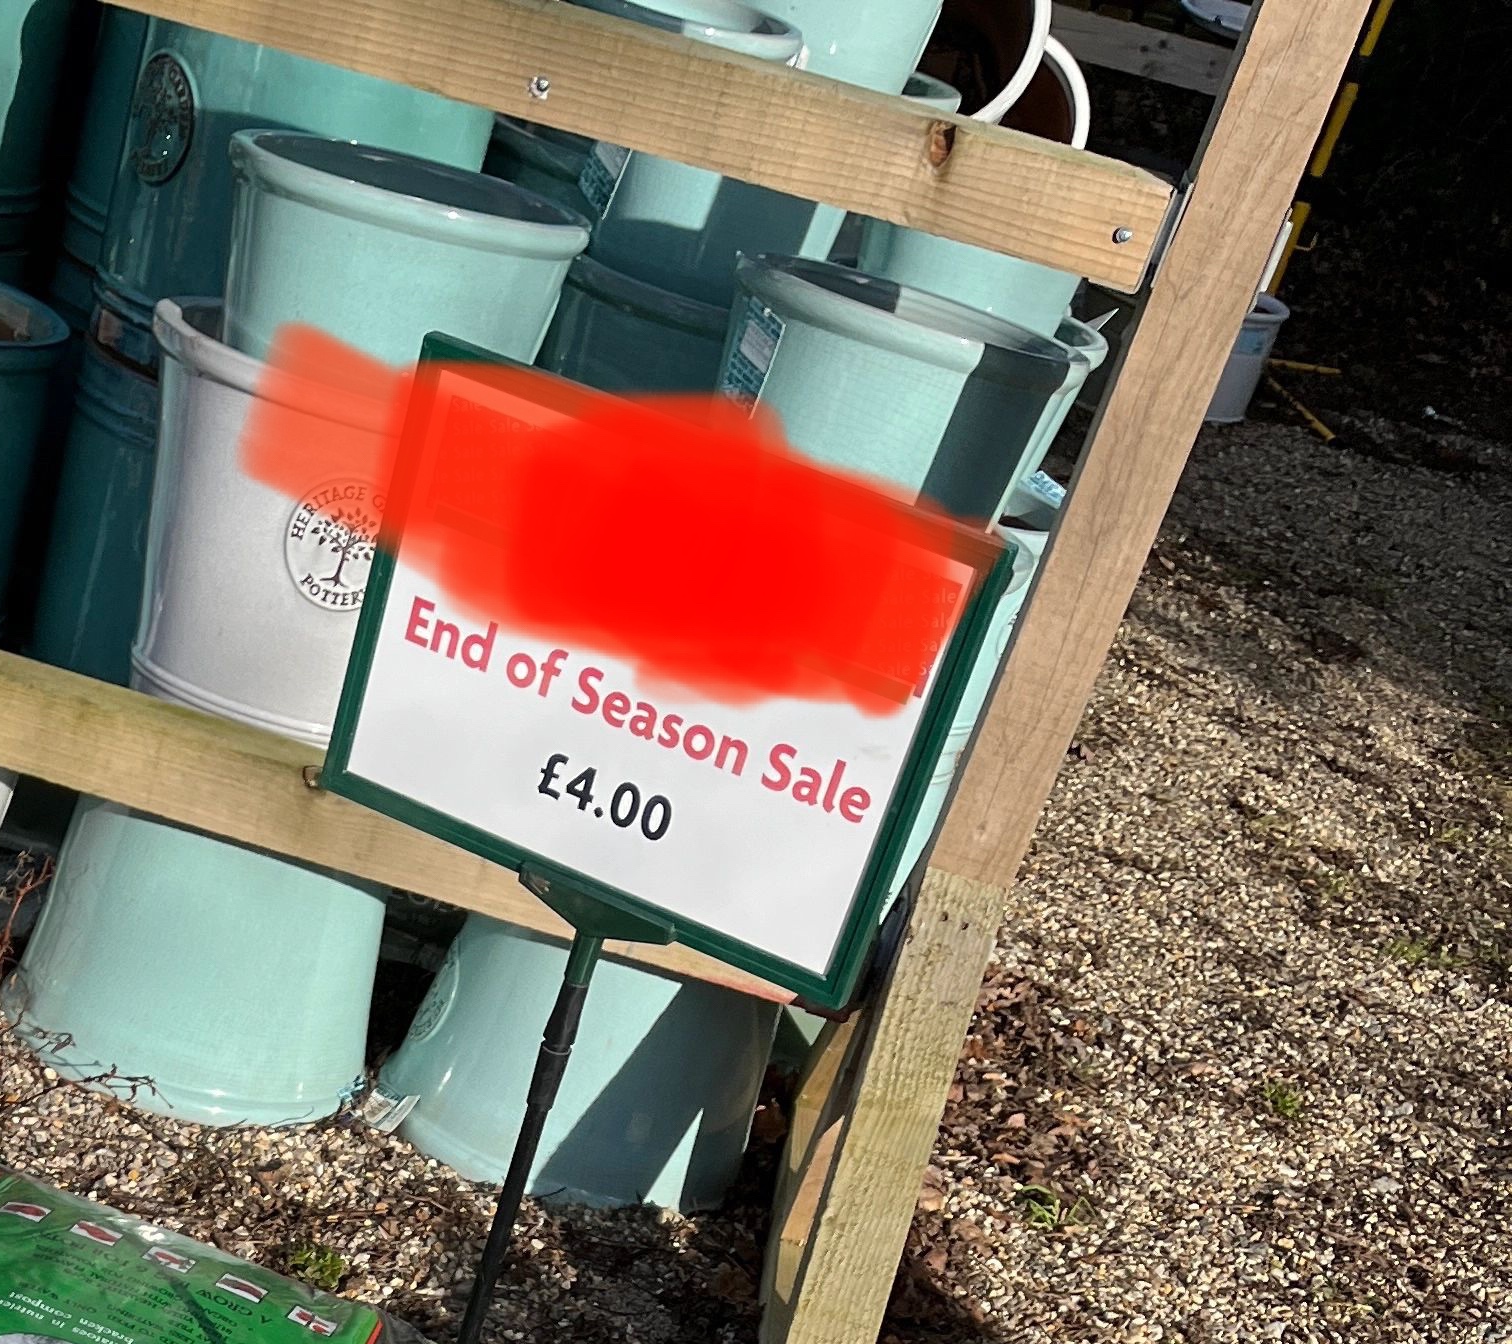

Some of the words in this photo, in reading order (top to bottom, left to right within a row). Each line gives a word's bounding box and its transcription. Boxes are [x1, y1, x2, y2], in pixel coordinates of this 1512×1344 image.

[291, 485, 367, 540] HERITAGE
[300, 573, 365, 606] POTTER
[404, 595, 499, 673] End
[506, 648, 568, 698] of
[571, 666, 749, 777] Season
[761, 743, 872, 824] Sale
[536, 752, 673, 842] £4.00
[9, 1291, 73, 1321] compost
